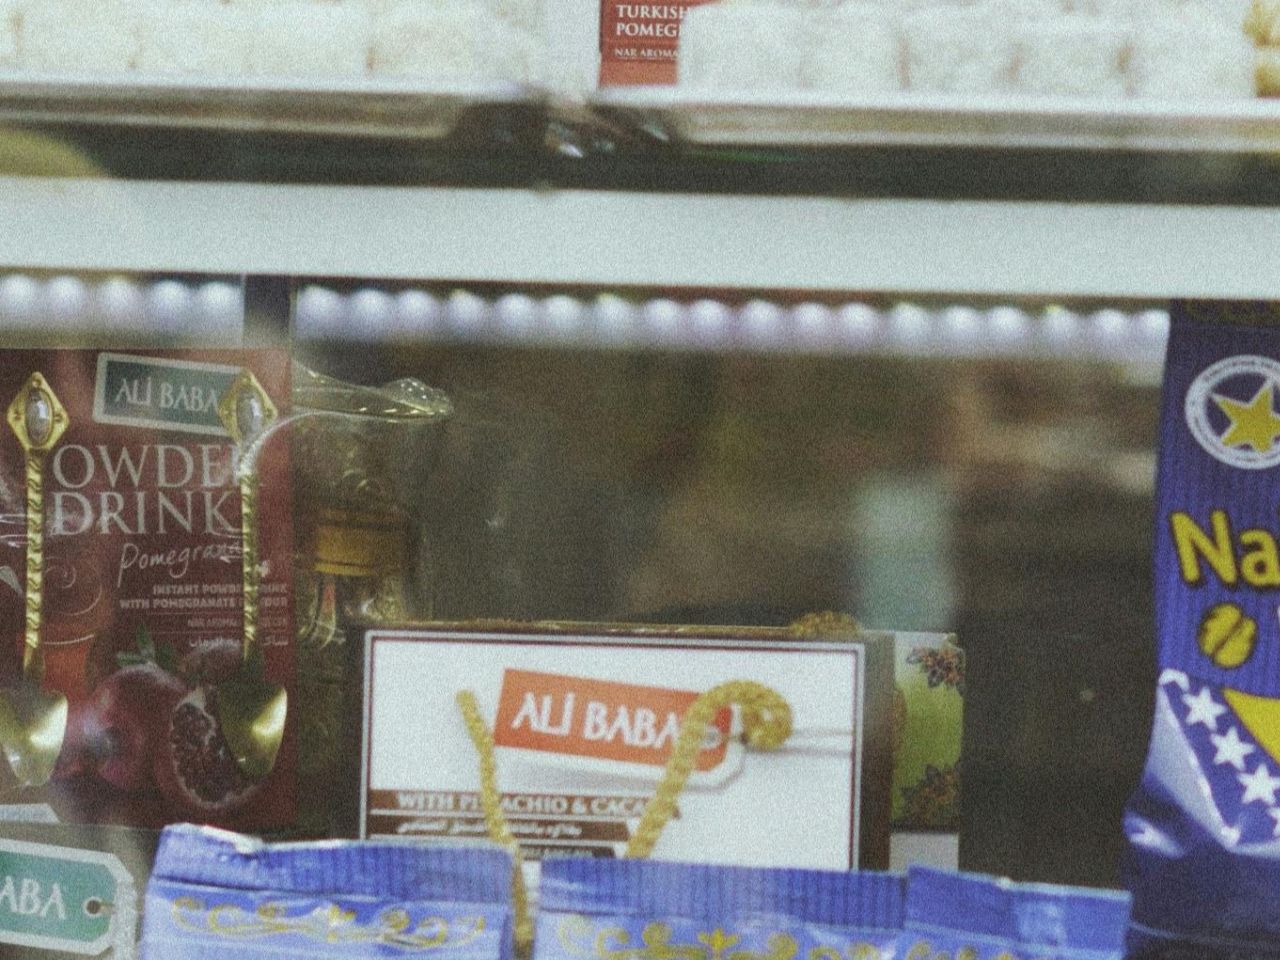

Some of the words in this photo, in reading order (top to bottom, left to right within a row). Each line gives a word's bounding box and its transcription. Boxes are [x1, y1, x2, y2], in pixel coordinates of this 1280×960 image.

[52, 490, 244, 537] DRINK
[457, 791, 568, 816] PIACHIO
[591, 797, 652, 817] CACA
[0, 875, 66, 920] ABA
